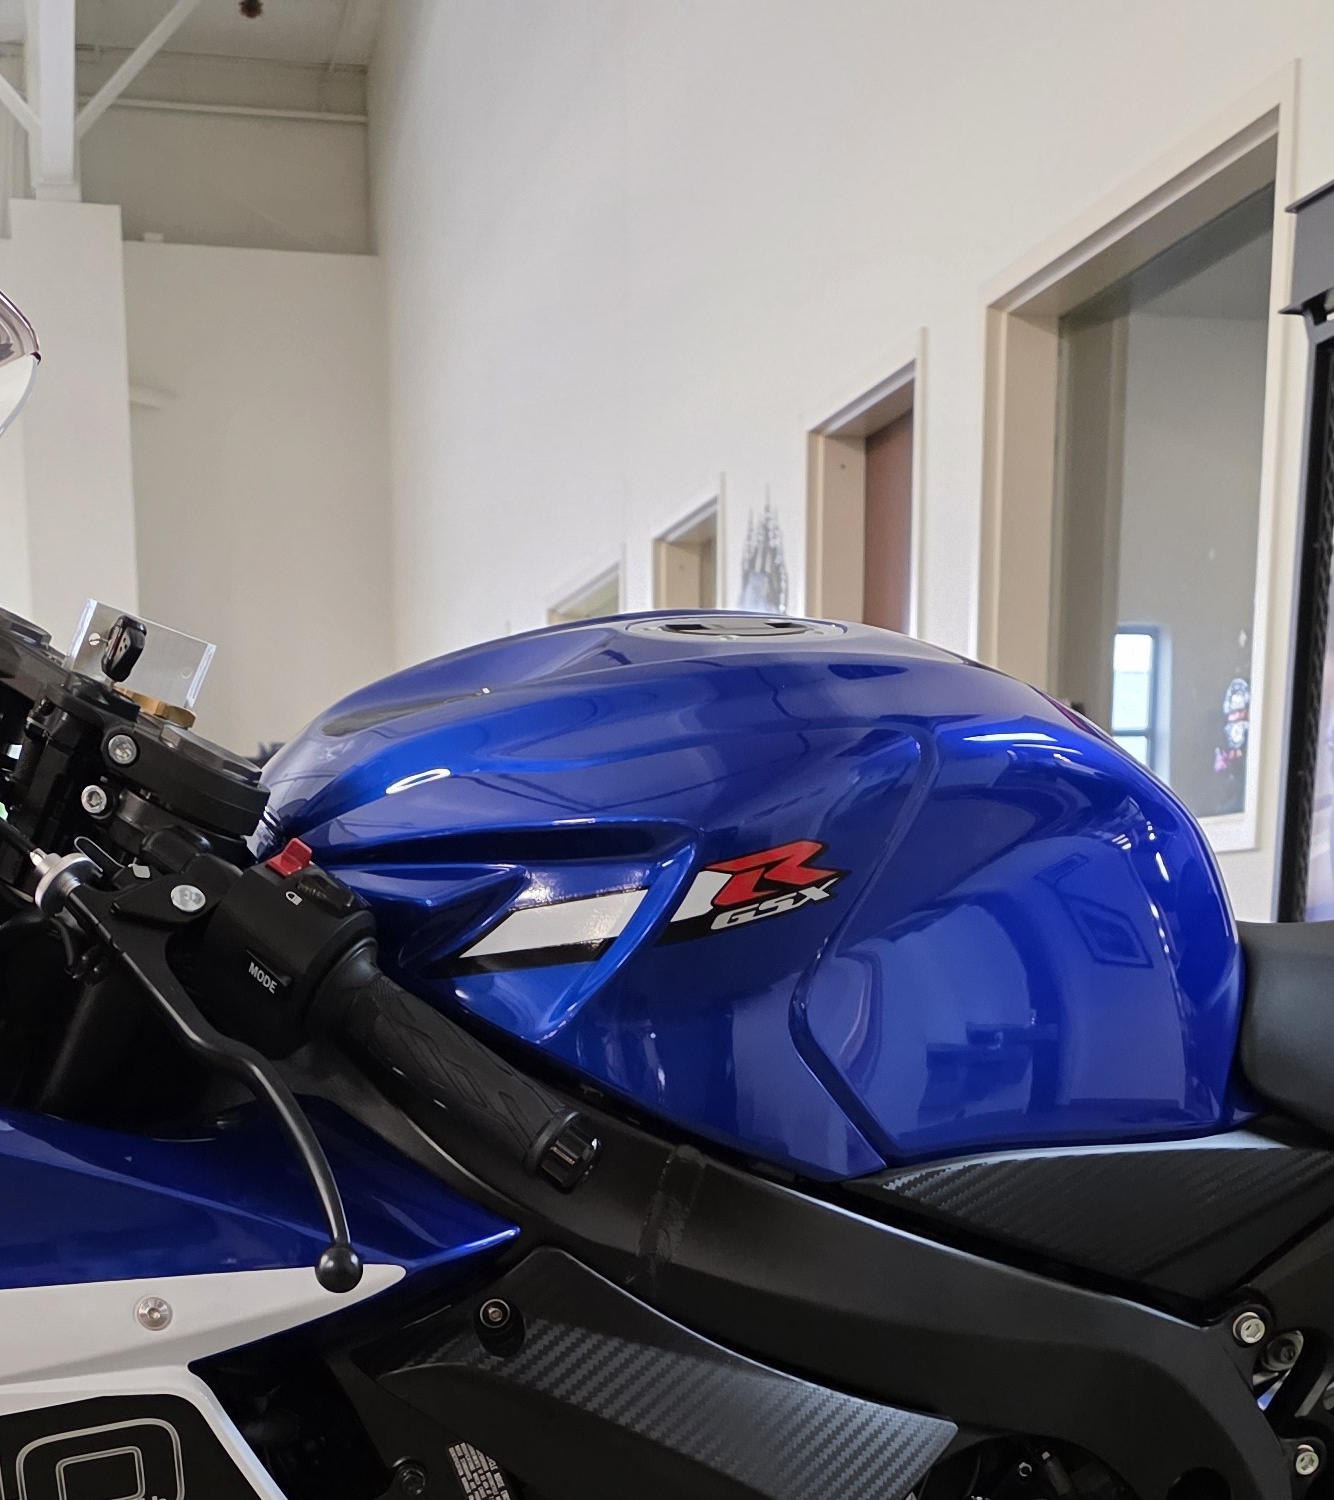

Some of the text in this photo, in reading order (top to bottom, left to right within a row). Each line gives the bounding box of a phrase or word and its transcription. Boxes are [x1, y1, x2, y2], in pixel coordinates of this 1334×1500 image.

[704, 839, 839, 907] R
[710, 877, 840, 931] GSX
[248, 961, 278, 995] MODE
